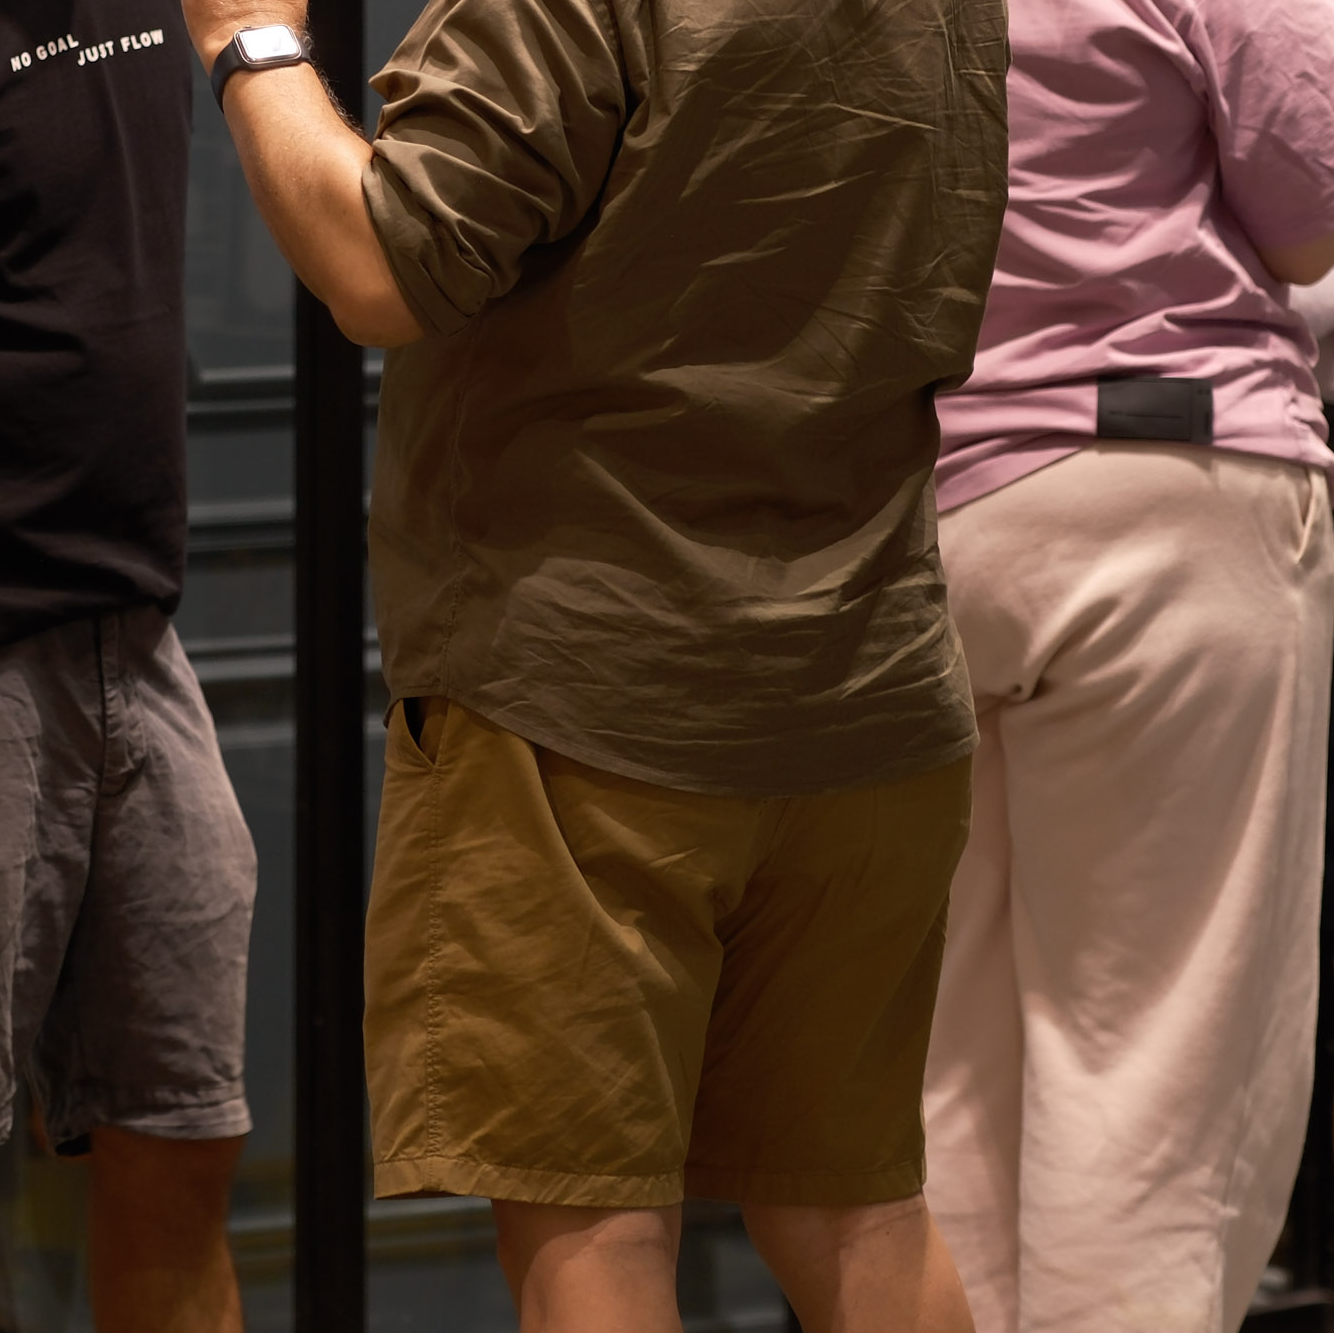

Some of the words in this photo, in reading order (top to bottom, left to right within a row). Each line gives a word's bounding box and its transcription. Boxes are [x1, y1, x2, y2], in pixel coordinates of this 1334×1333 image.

[10, 52, 32, 72] NO
[36, 34, 79, 60] GOAL
[77, 41, 114, 66] JUST
[120, 29, 164, 52] FLOW
